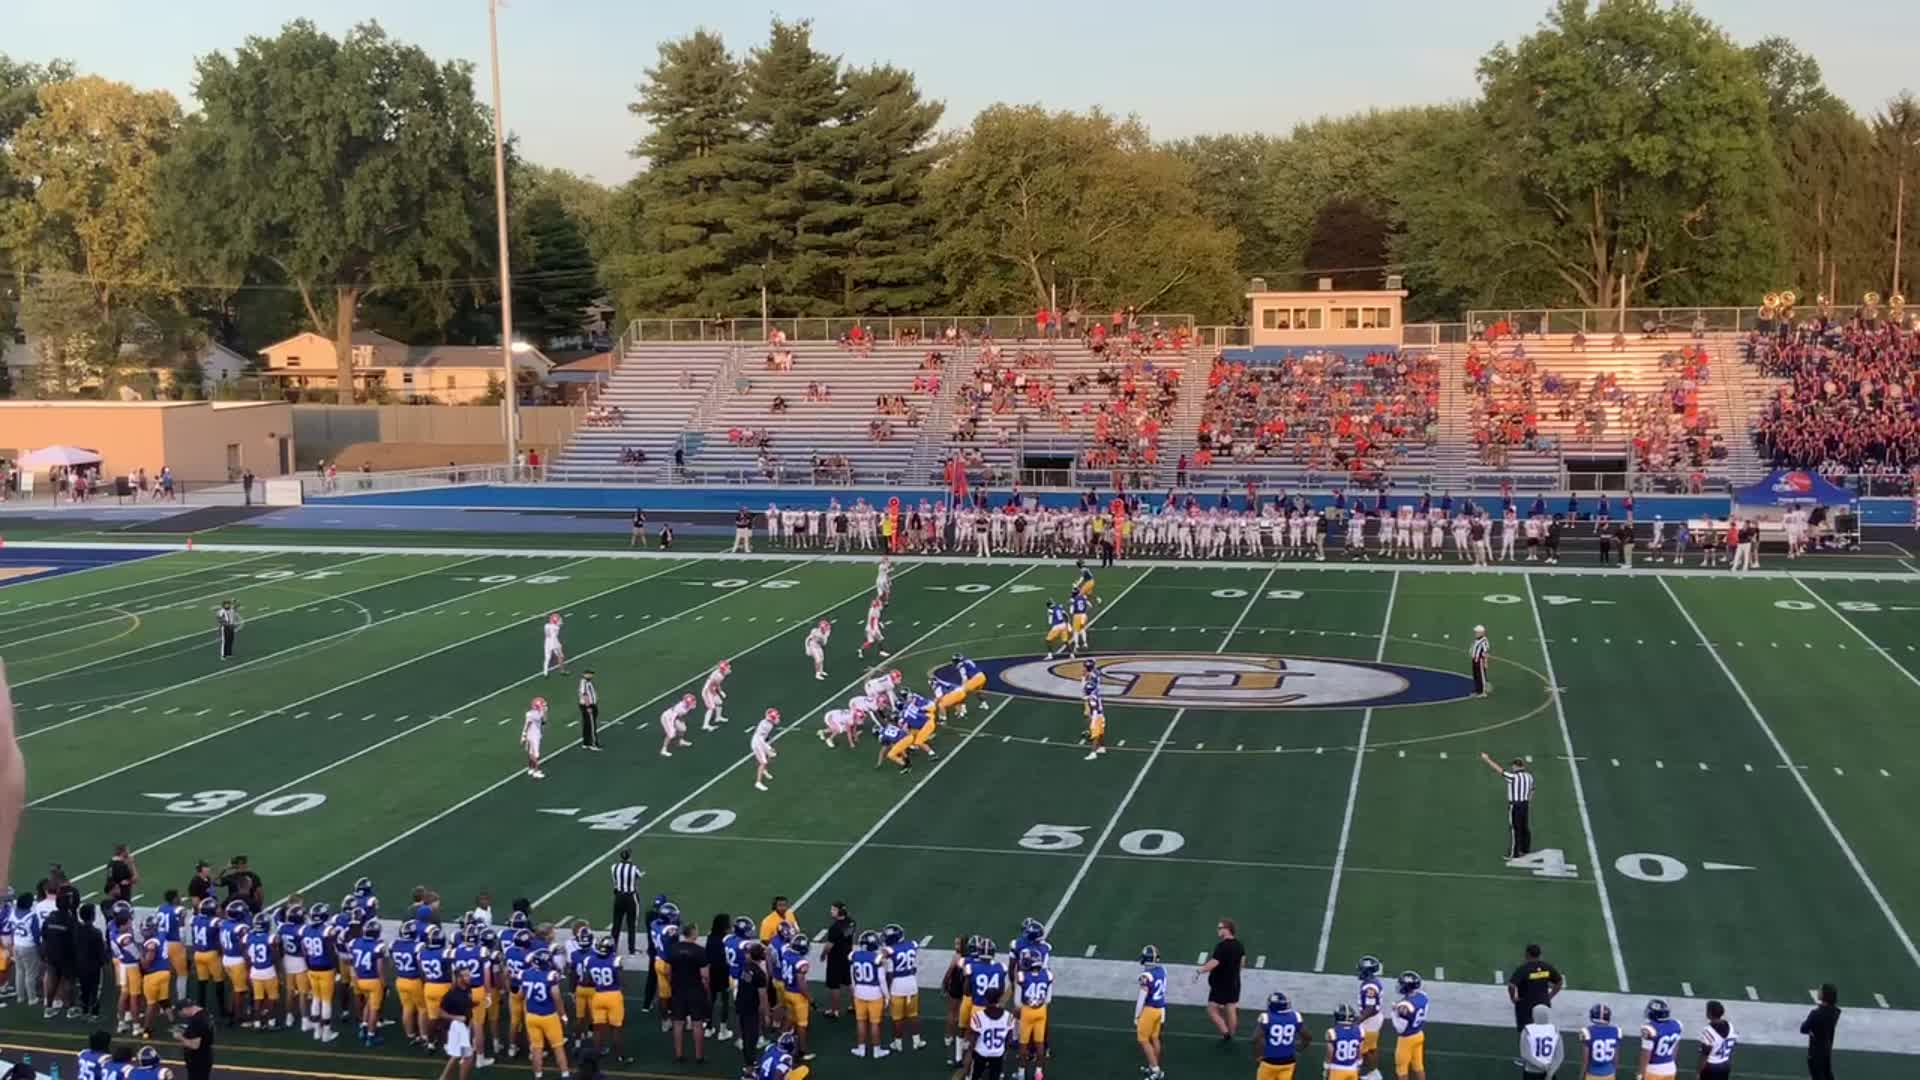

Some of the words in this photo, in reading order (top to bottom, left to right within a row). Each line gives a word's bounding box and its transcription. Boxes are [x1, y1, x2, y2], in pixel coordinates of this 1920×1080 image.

[353, 949, 372, 971] 74
[392, 952, 416, 973] 52
[421, 958, 443, 979] 53
[896, 950, 916, 972] 26
[590, 966, 613, 986] 68
[853, 962, 874, 983] 30
[523, 980, 548, 1001] 73
[976, 973, 1000, 996] 94
[1024, 982, 1047, 1002] 46
[1269, 1023, 1296, 1047] 99
[1335, 1039, 1360, 1061] 86
[1535, 1036, 1553, 1057] 16
[1592, 1038, 1617, 1062] 85
